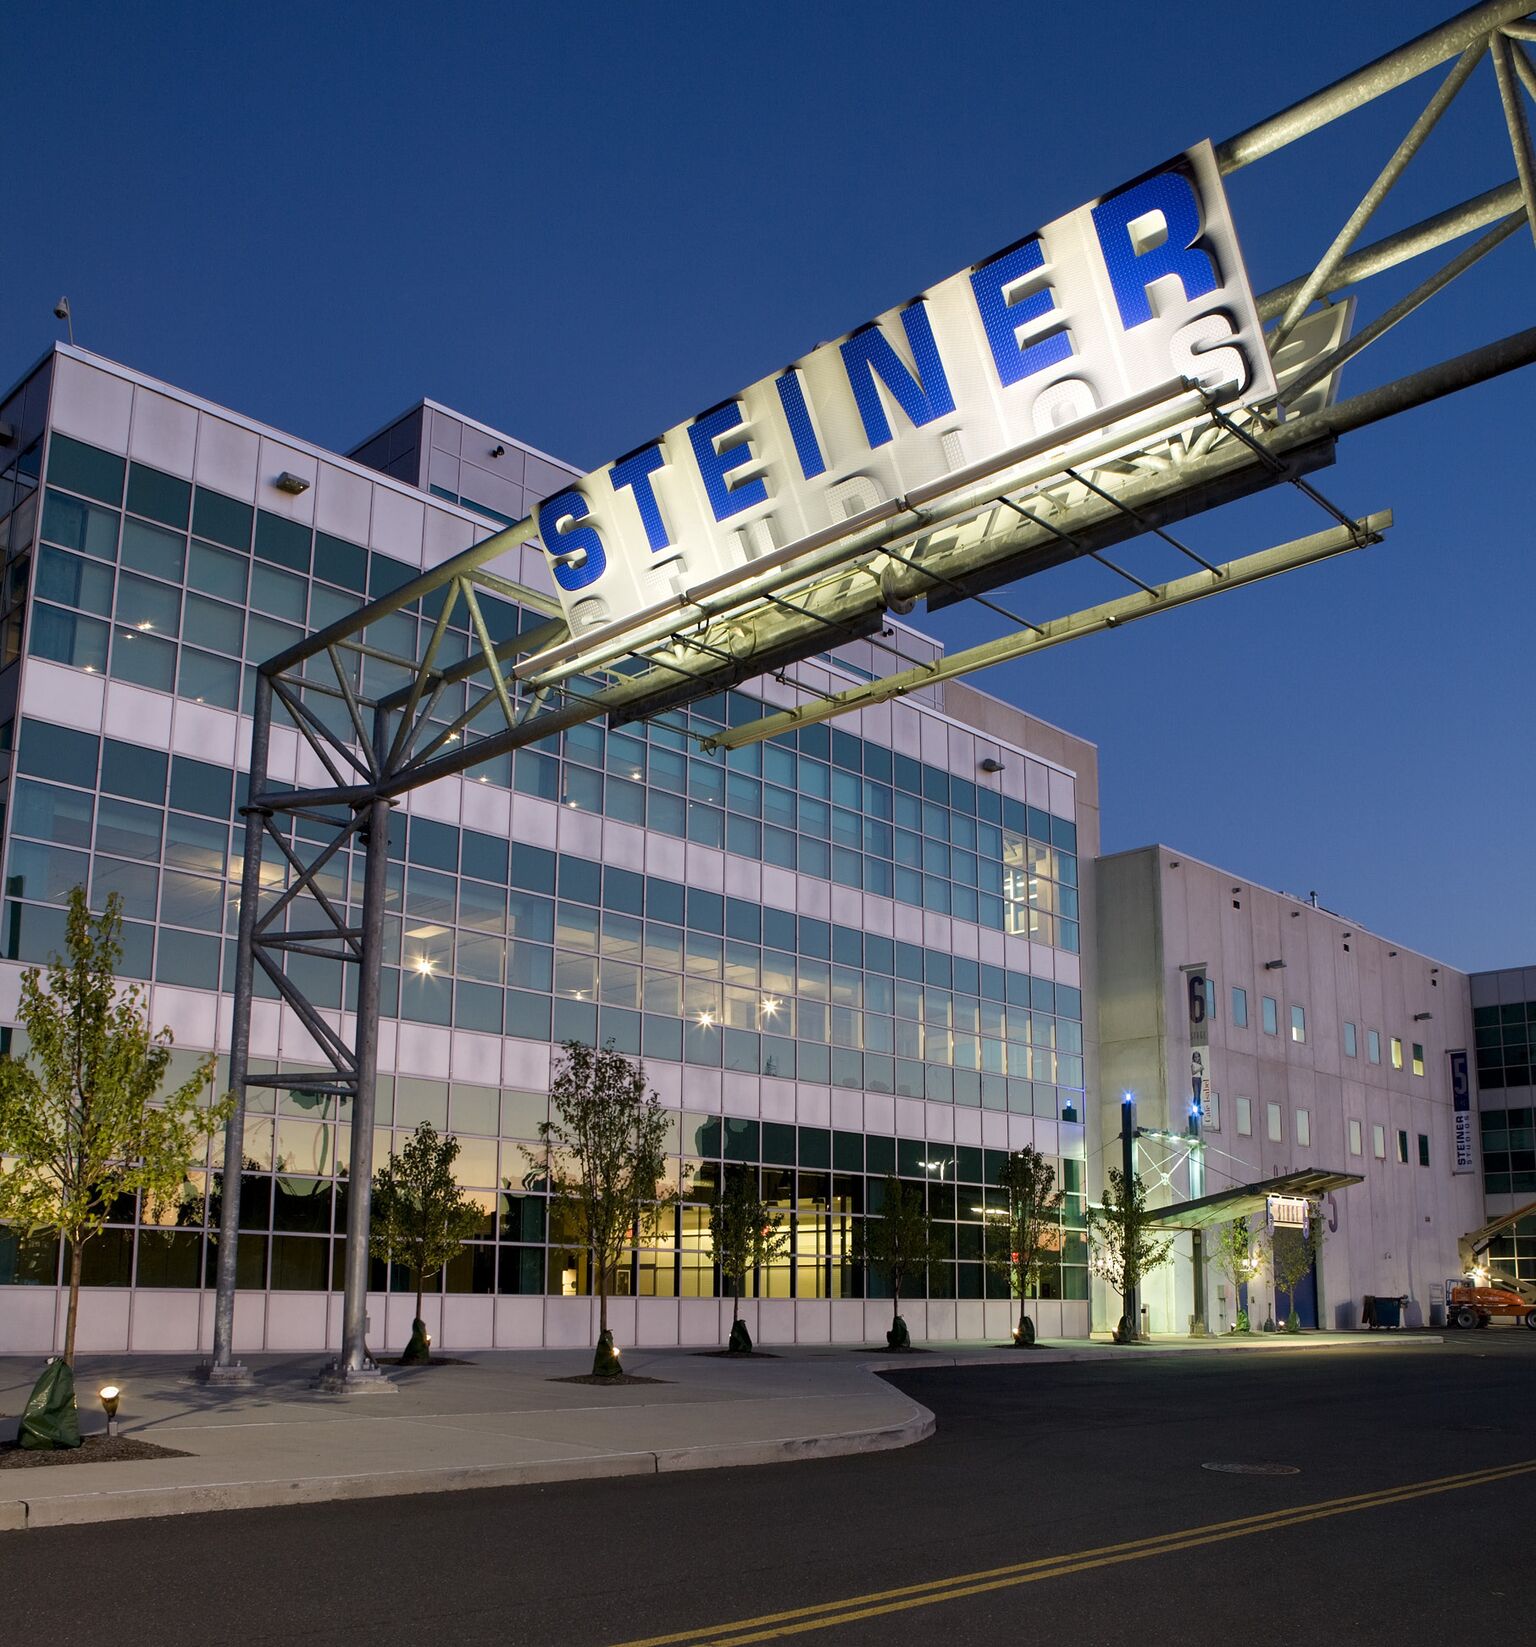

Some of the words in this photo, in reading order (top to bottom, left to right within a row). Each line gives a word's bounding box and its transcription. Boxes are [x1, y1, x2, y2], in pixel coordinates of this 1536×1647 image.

[538, 170, 1224, 591] STEINER
[1189, 976, 1205, 1024] 6
[1454, 1058, 1467, 1095] 5
[1456, 1115, 1466, 1165] STEINER
[1464, 1115, 1473, 1164] STUDIOS
